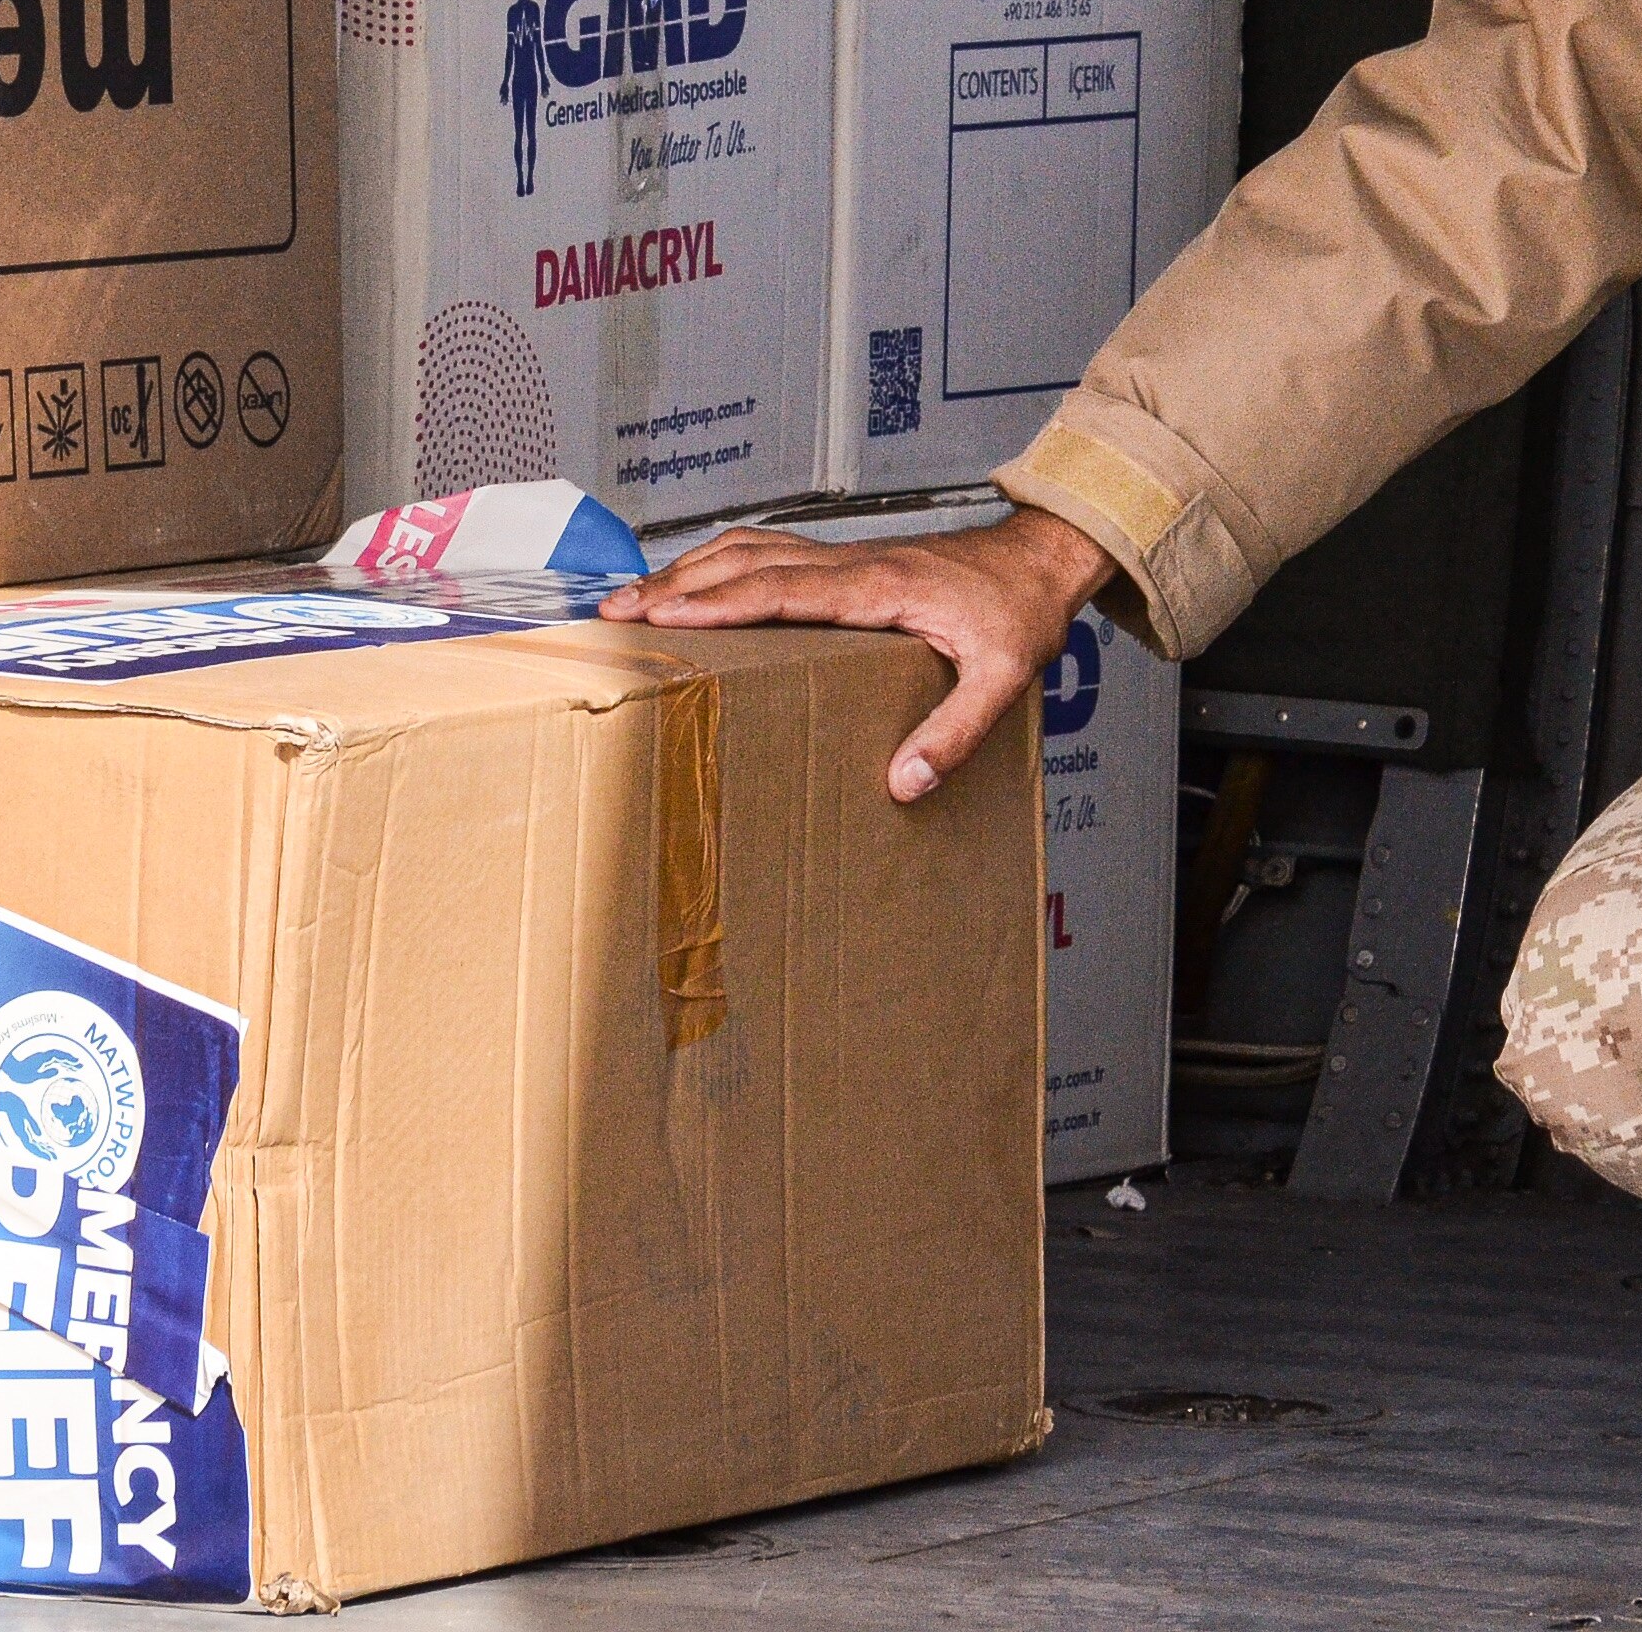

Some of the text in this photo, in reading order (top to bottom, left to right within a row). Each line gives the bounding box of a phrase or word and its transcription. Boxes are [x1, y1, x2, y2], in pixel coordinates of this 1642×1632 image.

[1003, 2, 1023, 21] +90
[1023, 1, 1043, 20] 212
[1044, 0, 1063, 19] 486
[545, 68, 748, 129] General Medical Disposable
[956, 62, 1117, 101] CONTENTS İÇERİK
[627, 136, 654, 176] You
[657, 130, 702, 170] Matter
[704, 120, 723, 162] To
[535, 219, 724, 310] DAMACRYL
[110, 403, 133, 436] 30
[615, 395, 757, 441] www.gmdgroup.com.tr
[615, 439, 754, 486] info@gmdgroup.com.tr
[1054, 795, 1073, 833] To
[12, 1012, 58, 1032] Muslims
[83, 1022, 136, 1185] MATW-PROJ
